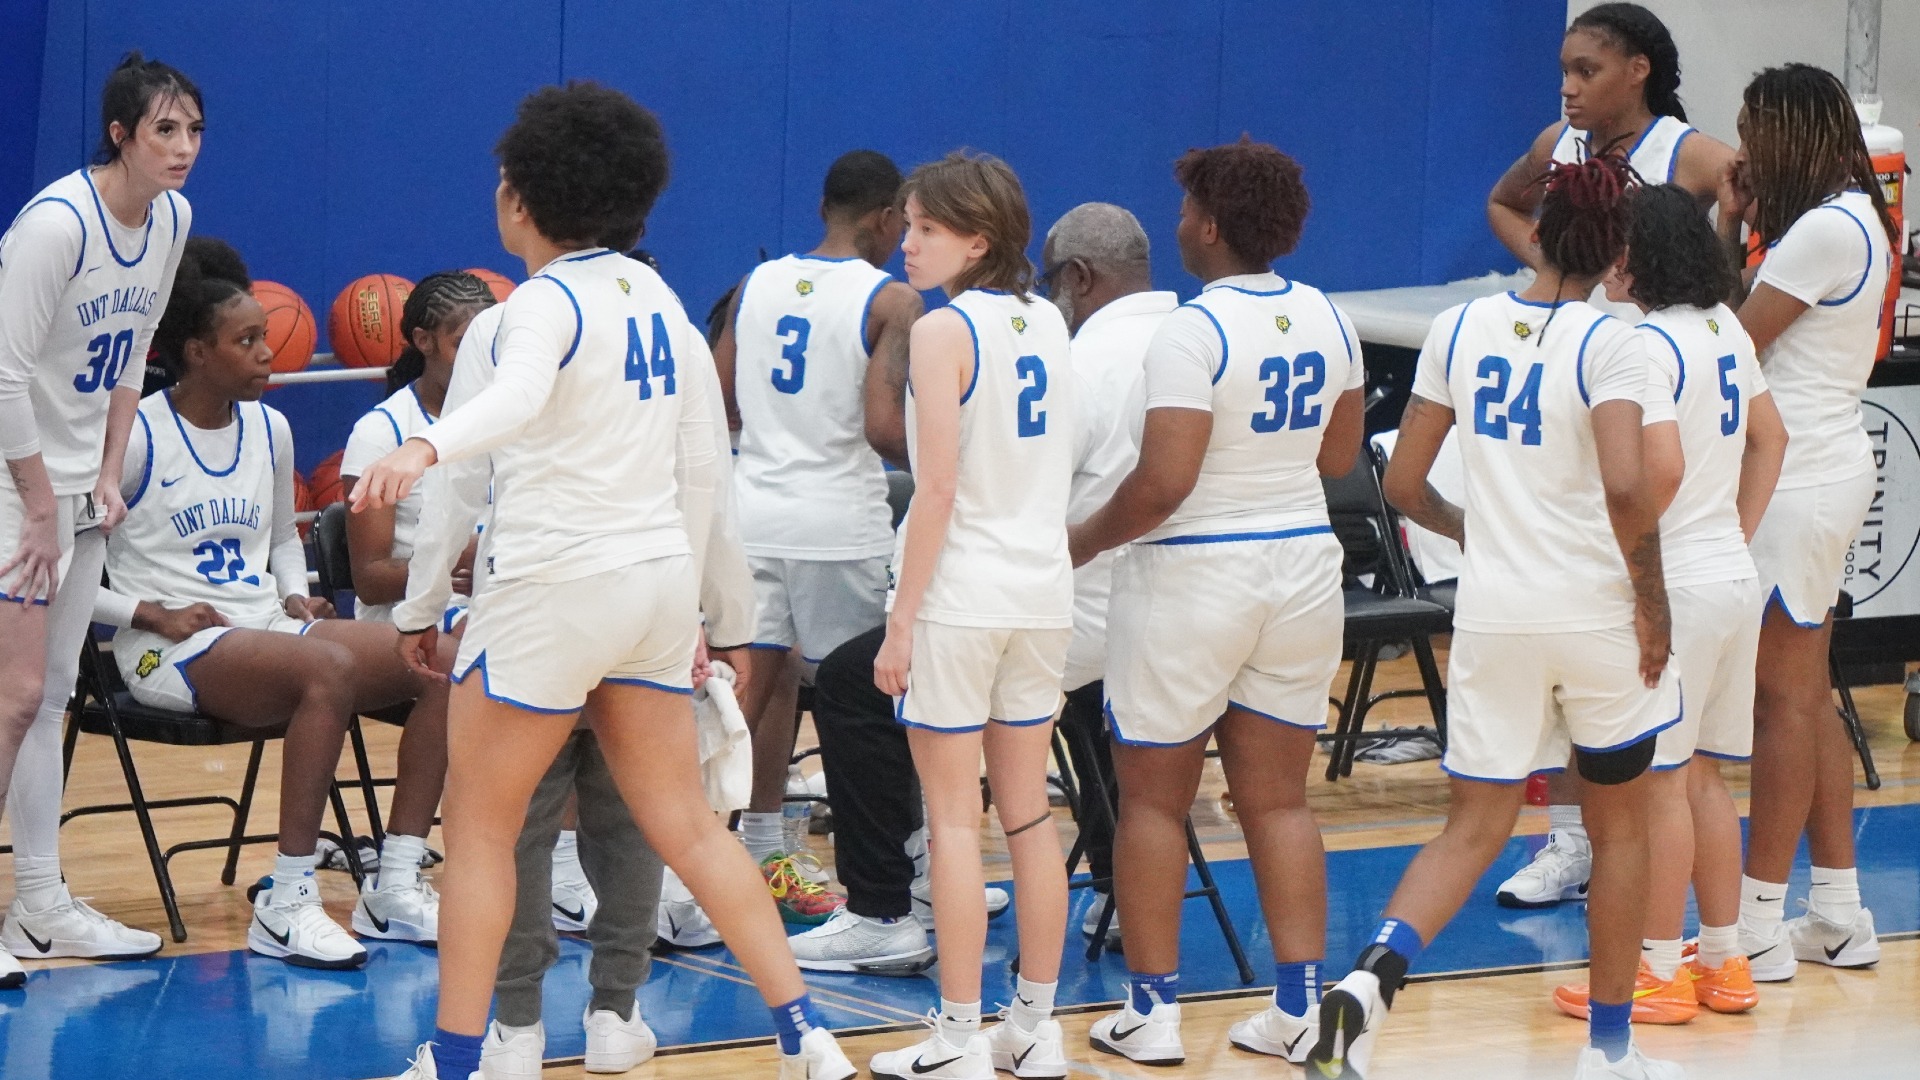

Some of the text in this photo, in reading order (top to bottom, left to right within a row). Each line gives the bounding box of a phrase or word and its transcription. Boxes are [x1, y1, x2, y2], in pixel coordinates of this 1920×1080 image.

[76, 286, 157, 327] UNT DALLAS
[367, 283, 385, 344] LEGACY
[73, 328, 134, 393] 30
[624, 312, 677, 401] 44
[771, 314, 812, 395] 3
[1250, 350, 1326, 434] 32
[1717, 353, 1740, 437] 5
[1015, 354, 1048, 438] 2
[1473, 355, 1544, 446] 24
[170, 497, 260, 538] UNT DALLAS
